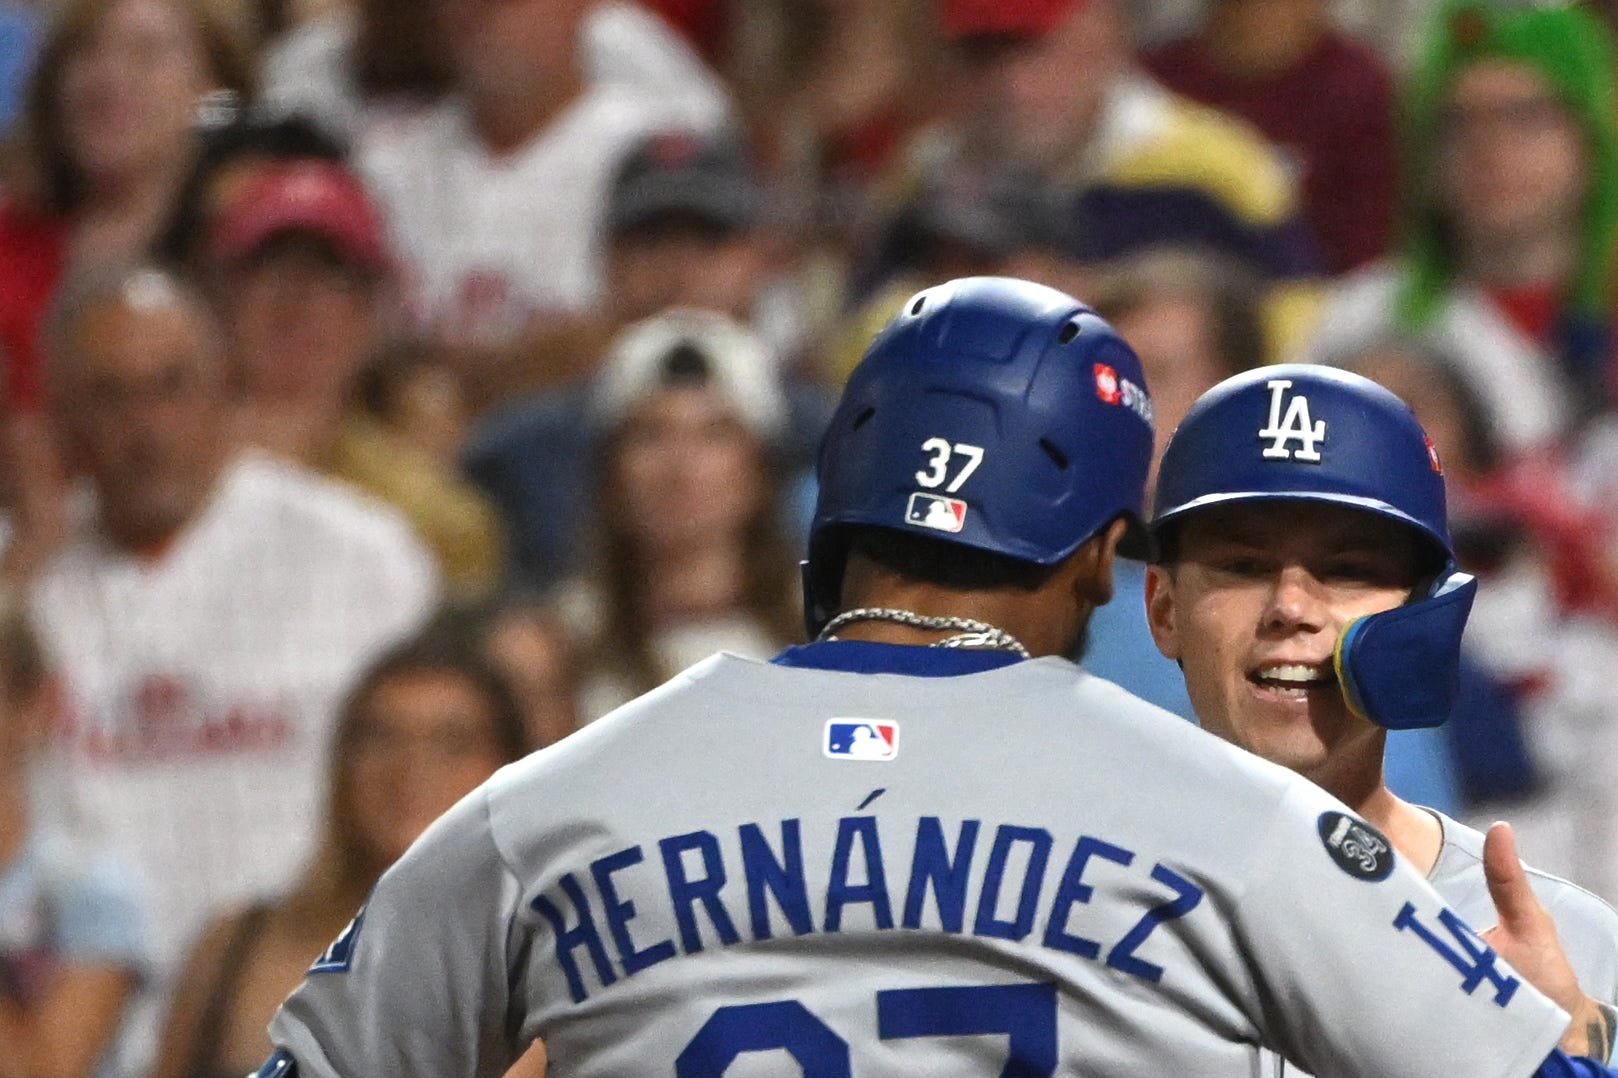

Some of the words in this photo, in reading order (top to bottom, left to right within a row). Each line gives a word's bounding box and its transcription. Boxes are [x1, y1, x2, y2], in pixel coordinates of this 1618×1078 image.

[915, 437, 985, 493] 37
[1258, 379, 1326, 461] LA
[529, 787, 1206, 1003] HERNÁNDEZ
[1392, 900, 1520, 1008] LA
